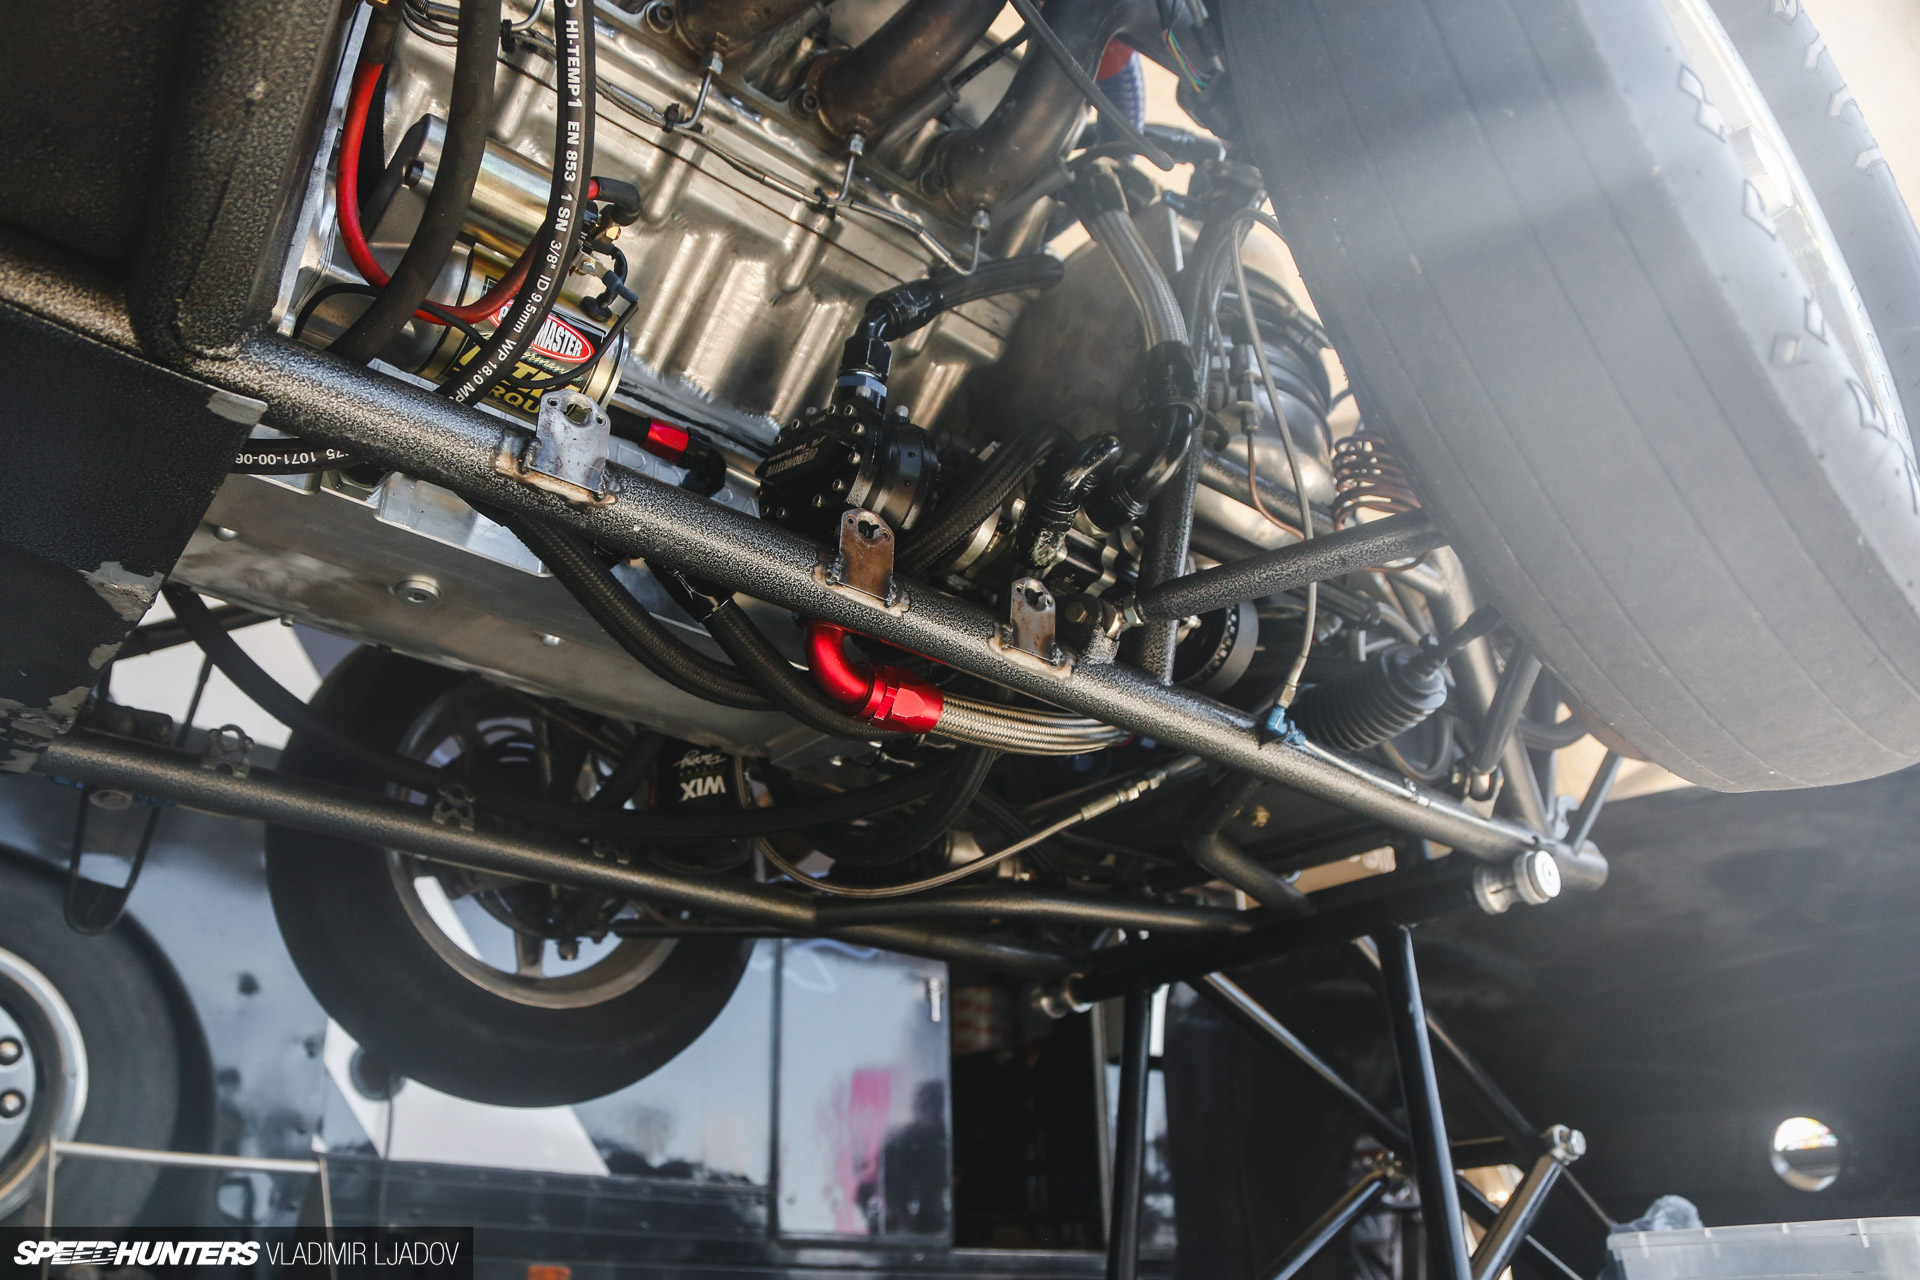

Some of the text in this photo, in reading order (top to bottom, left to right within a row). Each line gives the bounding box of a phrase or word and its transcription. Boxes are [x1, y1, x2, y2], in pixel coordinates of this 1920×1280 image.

[567, 120, 580, 146] EN
[564, 149, 578, 182] 853
[560, 193, 574, 202] 1
[554, 206, 571, 233] SN
[536, 274, 552, 292] ID
[497, 338, 517, 362] WP
[472, 360, 498, 386] 18,0
[449, 386, 476, 403] MP
[679, 775, 726, 802] WIX
